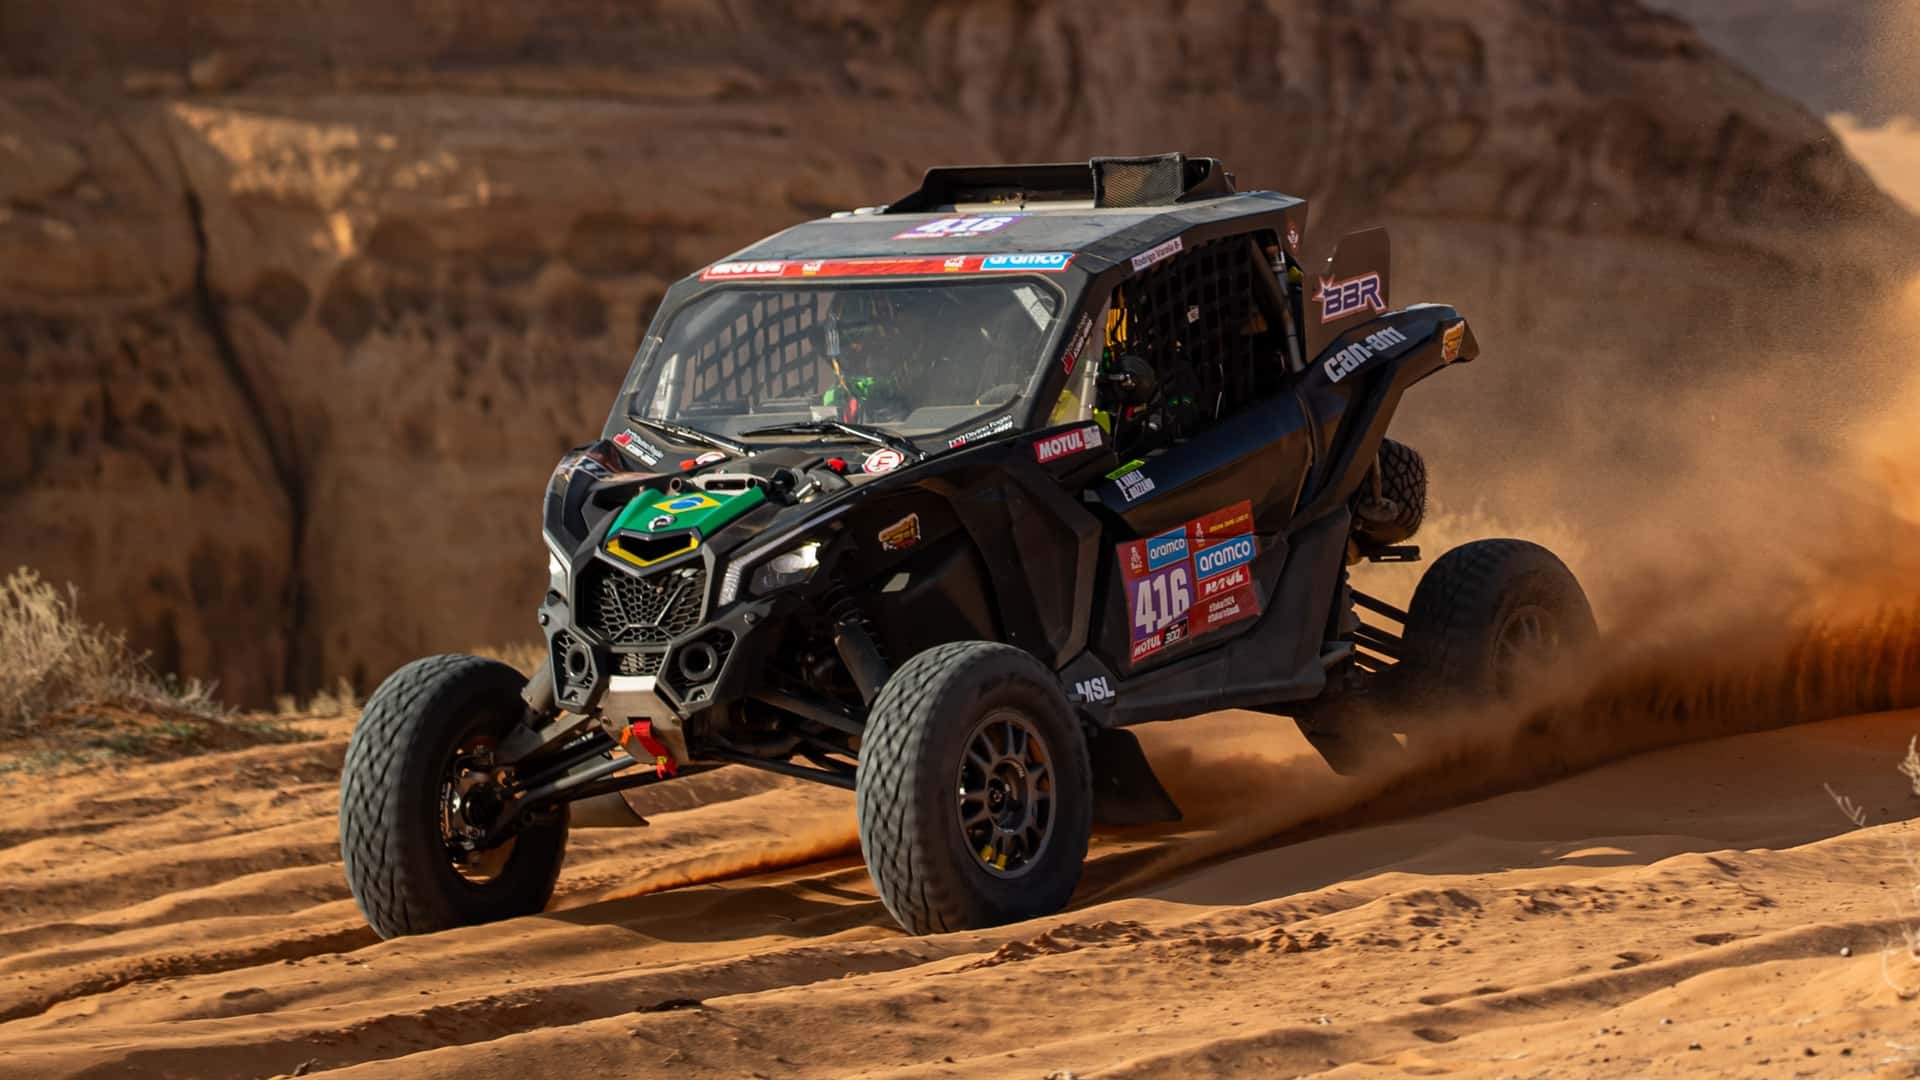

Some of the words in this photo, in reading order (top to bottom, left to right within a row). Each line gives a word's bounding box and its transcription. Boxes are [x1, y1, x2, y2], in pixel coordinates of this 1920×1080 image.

[914, 216, 1013, 232] 416
[988, 254, 1066, 265] aramco
[1322, 275, 1385, 318] BBR
[1039, 431, 1084, 460] MOTUL
[1150, 538, 1186, 560] aramco
[1199, 540, 1251, 572] aramco
[1135, 567, 1190, 634] 416
[1134, 634, 1162, 657] MOTUL
[1075, 676, 1116, 703] MSL
